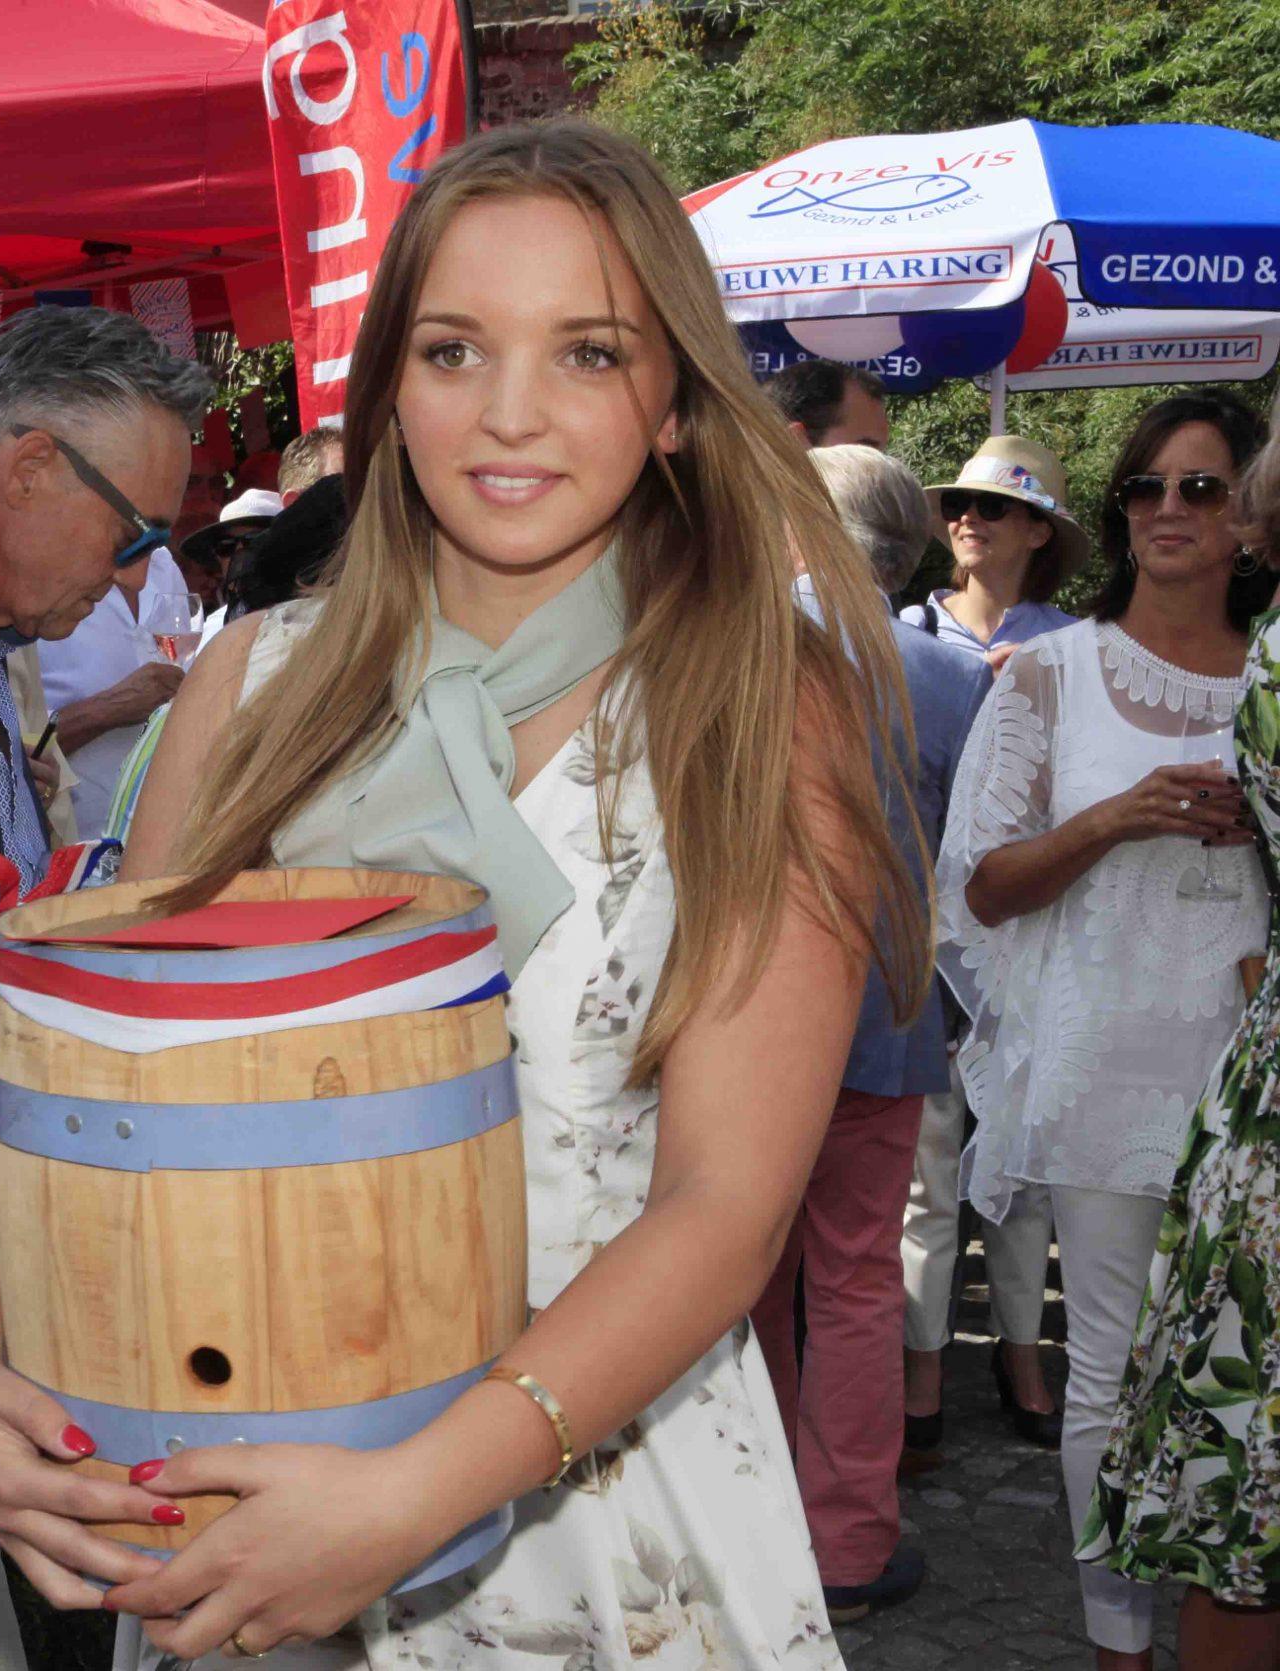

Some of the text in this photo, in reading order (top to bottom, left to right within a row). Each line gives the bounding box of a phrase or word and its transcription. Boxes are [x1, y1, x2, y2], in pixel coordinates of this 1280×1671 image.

[763, 149, 1017, 188] Onze Vis
[802, 193, 984, 226] Gezond & Lekker
[724, 253, 1003, 291] EUWE HARING
[1101, 254, 1277, 284] GEZOND &
